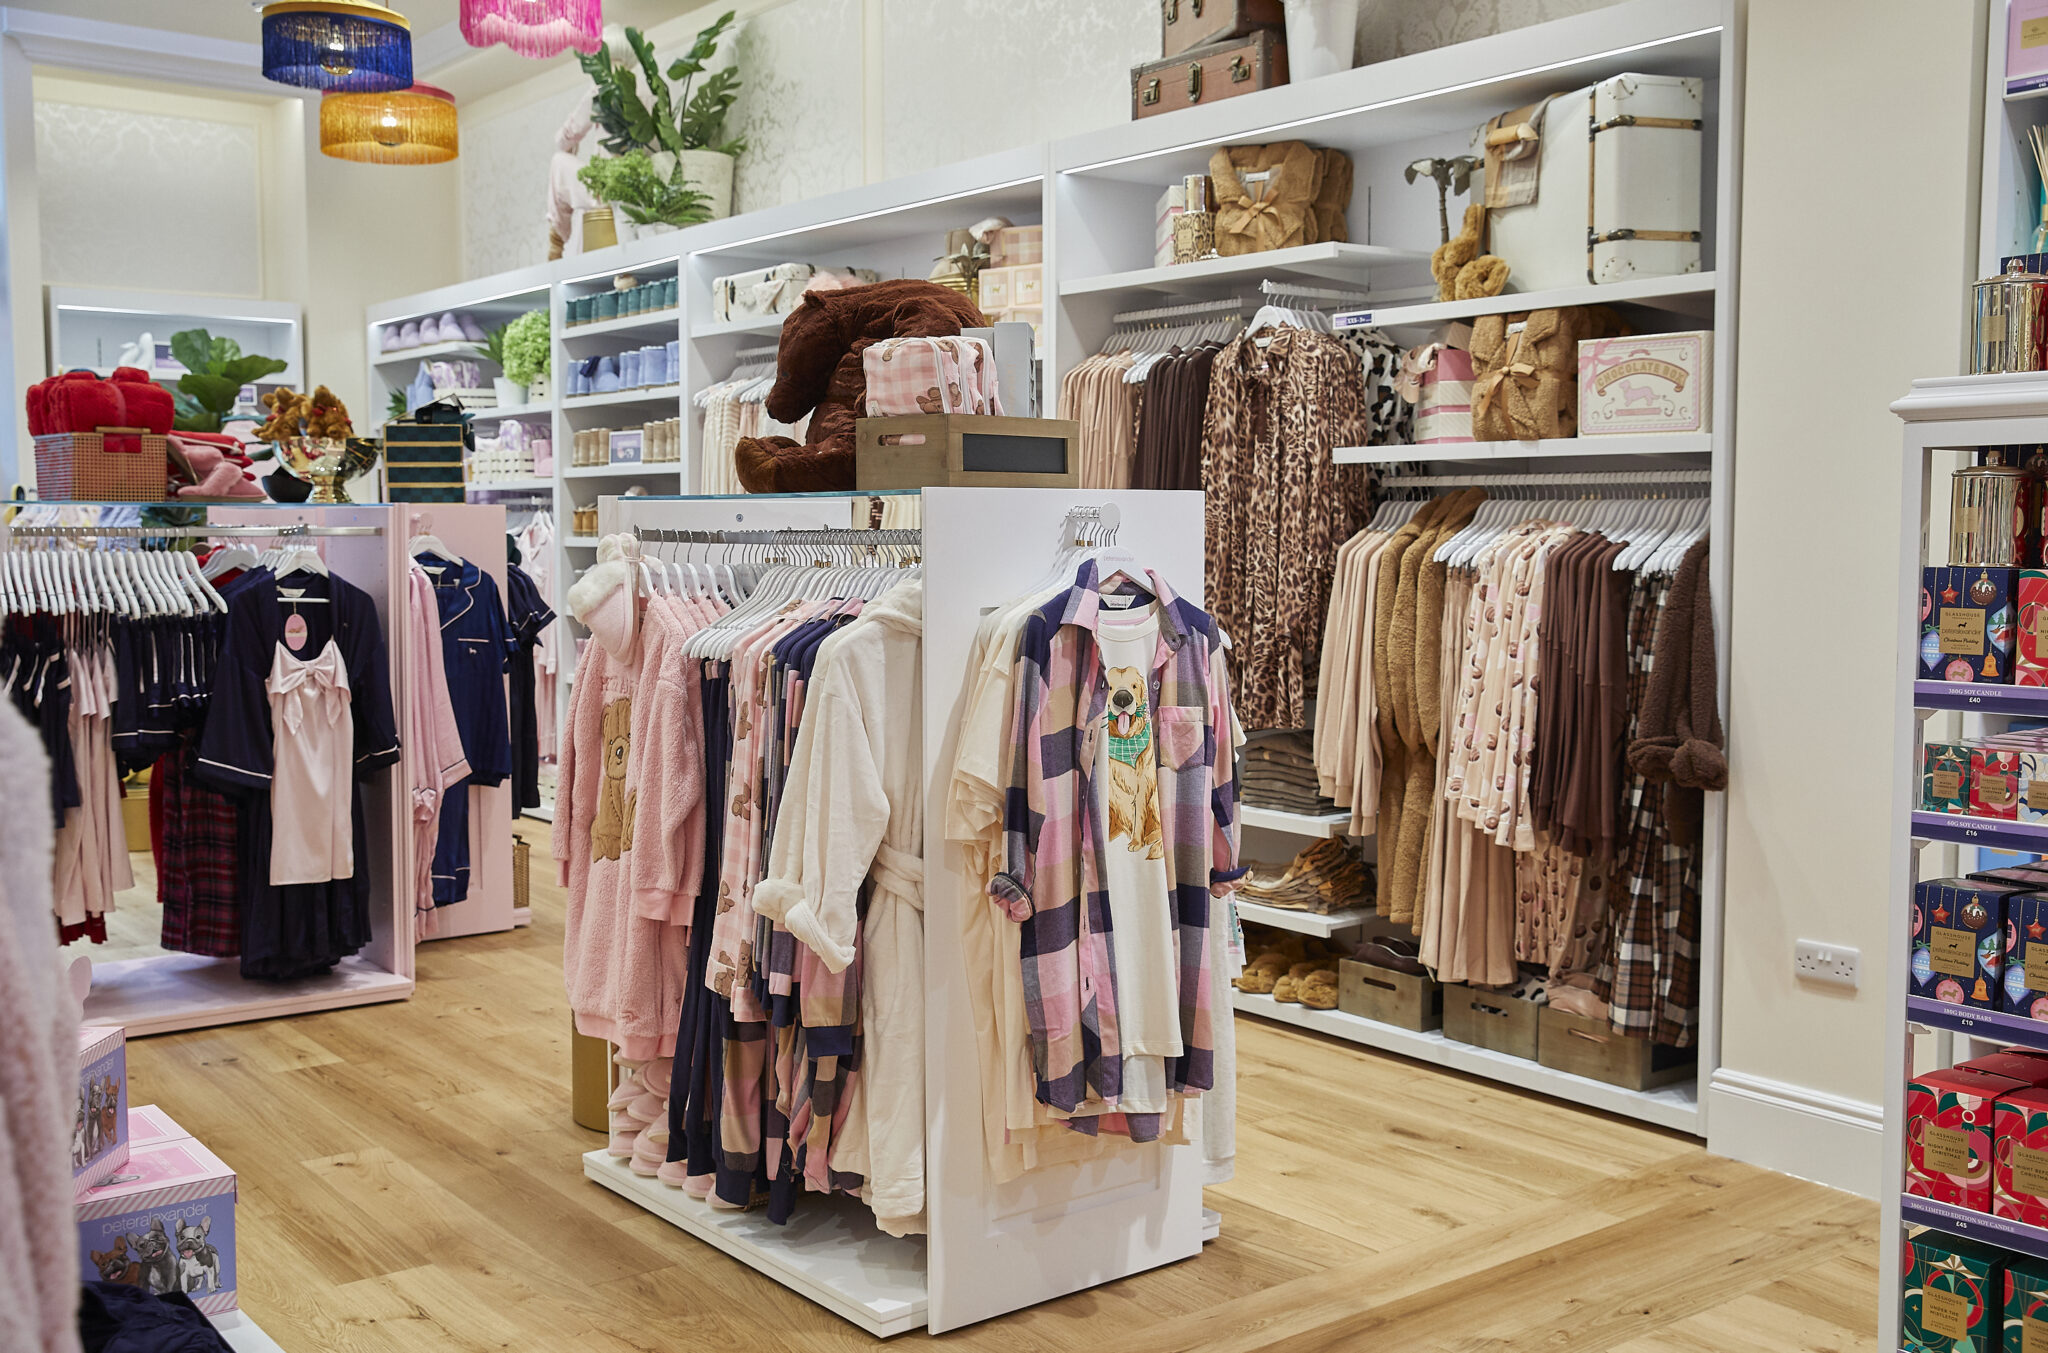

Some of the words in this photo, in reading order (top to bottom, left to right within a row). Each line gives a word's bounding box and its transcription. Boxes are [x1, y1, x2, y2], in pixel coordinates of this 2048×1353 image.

[1597, 362, 1661, 386] CHOCOLATE
[1663, 366, 1684, 381] BOX
[1976, 689, 2002, 697] CANDLE
[1971, 822, 1997, 831] CANDLE
[1965, 829, 1978, 837] £16
[1935, 931, 1971, 940] GLASSHOUSE
[1958, 1011, 1975, 1019] BODY
[1975, 1014, 1992, 1022] BARS
[1929, 1131, 1964, 1142] GLASSHOUSE
[1931, 1149, 1961, 1159] CHRISTMAS
[1945, 1147, 1965, 1155] BEFORE
[1925, 1206, 1950, 1217] LIMITED
[1950, 1211, 1976, 1223] EDITION
[1977, 1218, 1990, 1227] SOY
[1989, 1221, 2015, 1232] CANDLE
[1956, 1221, 1968, 1229] £45
[1930, 1304, 1948, 1313] UNDER
[1949, 1309, 1959, 1317] THE
[1930, 1310, 1958, 1322] MISTLETOE
